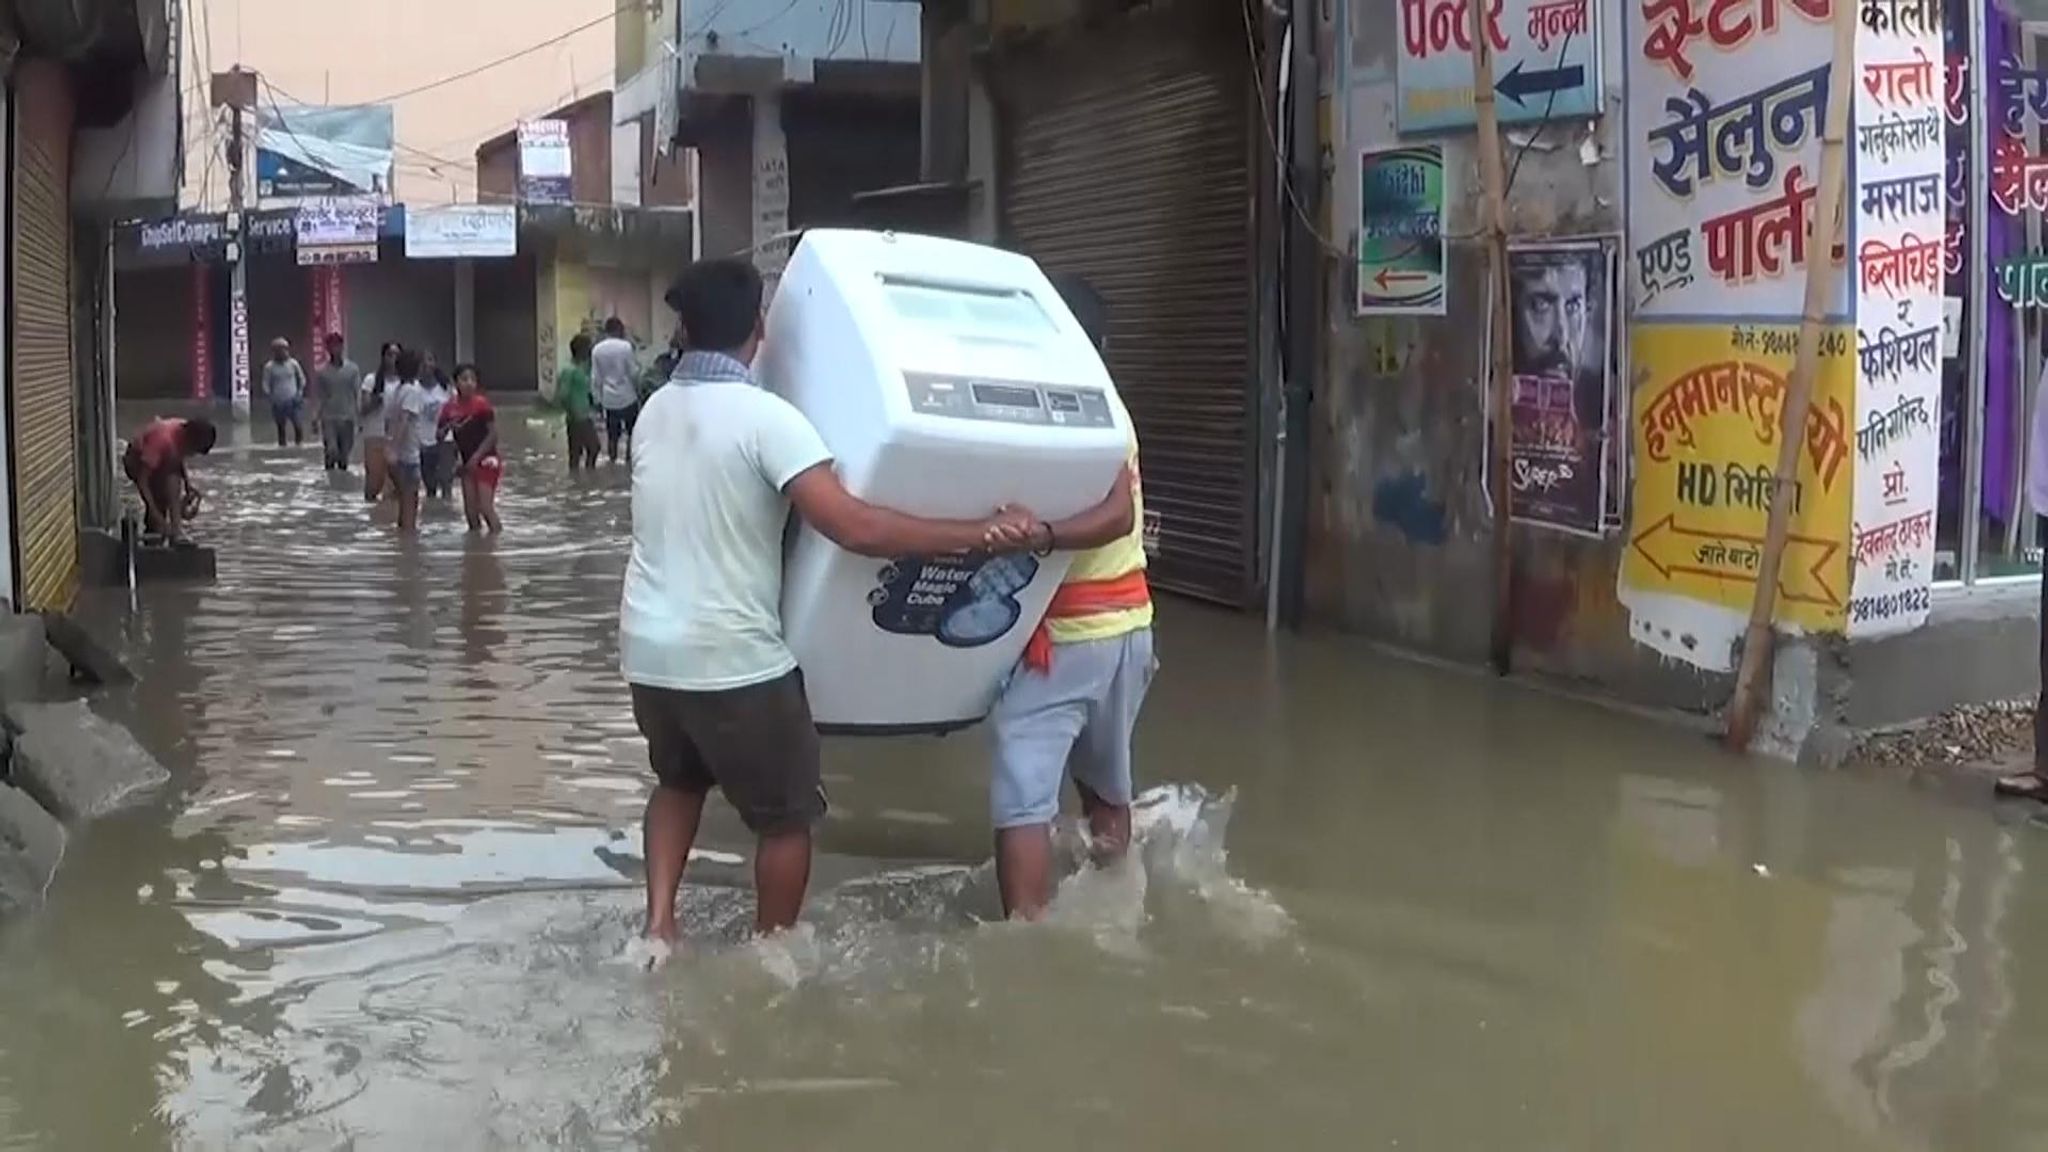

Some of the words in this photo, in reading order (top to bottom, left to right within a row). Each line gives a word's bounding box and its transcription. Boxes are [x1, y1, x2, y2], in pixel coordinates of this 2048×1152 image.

[1863, 46, 1934, 108] रातो
[1861, 173, 1941, 223] मसाज
[1677, 460, 1717, 507] HD
[911, 580, 957, 595] Magic
[920, 565, 974, 581] Water
[906, 592, 945, 605] Cube
